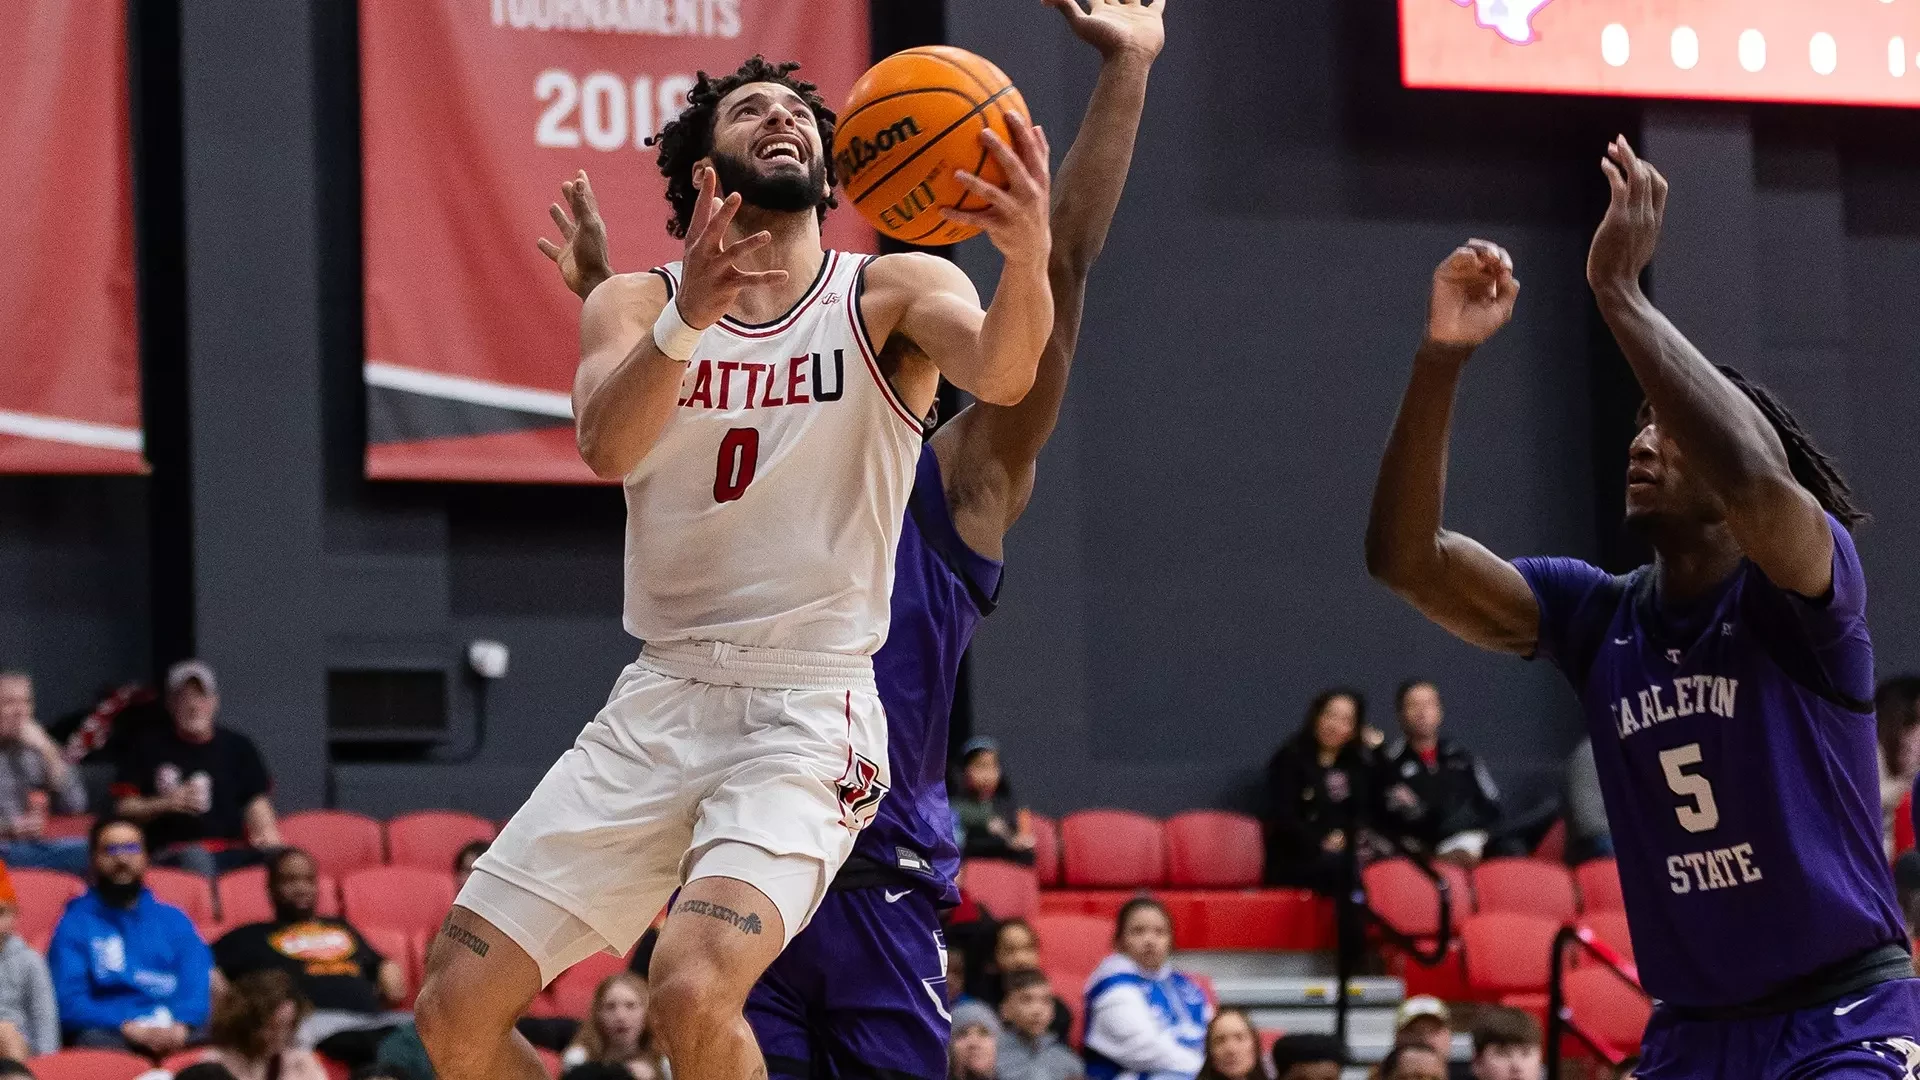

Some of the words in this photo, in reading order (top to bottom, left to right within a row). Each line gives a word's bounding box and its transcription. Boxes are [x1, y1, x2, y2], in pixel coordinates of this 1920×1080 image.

[713, 427, 760, 504] 0
[1659, 743, 1719, 834] 5
[1666, 842, 1763, 894] STATE
